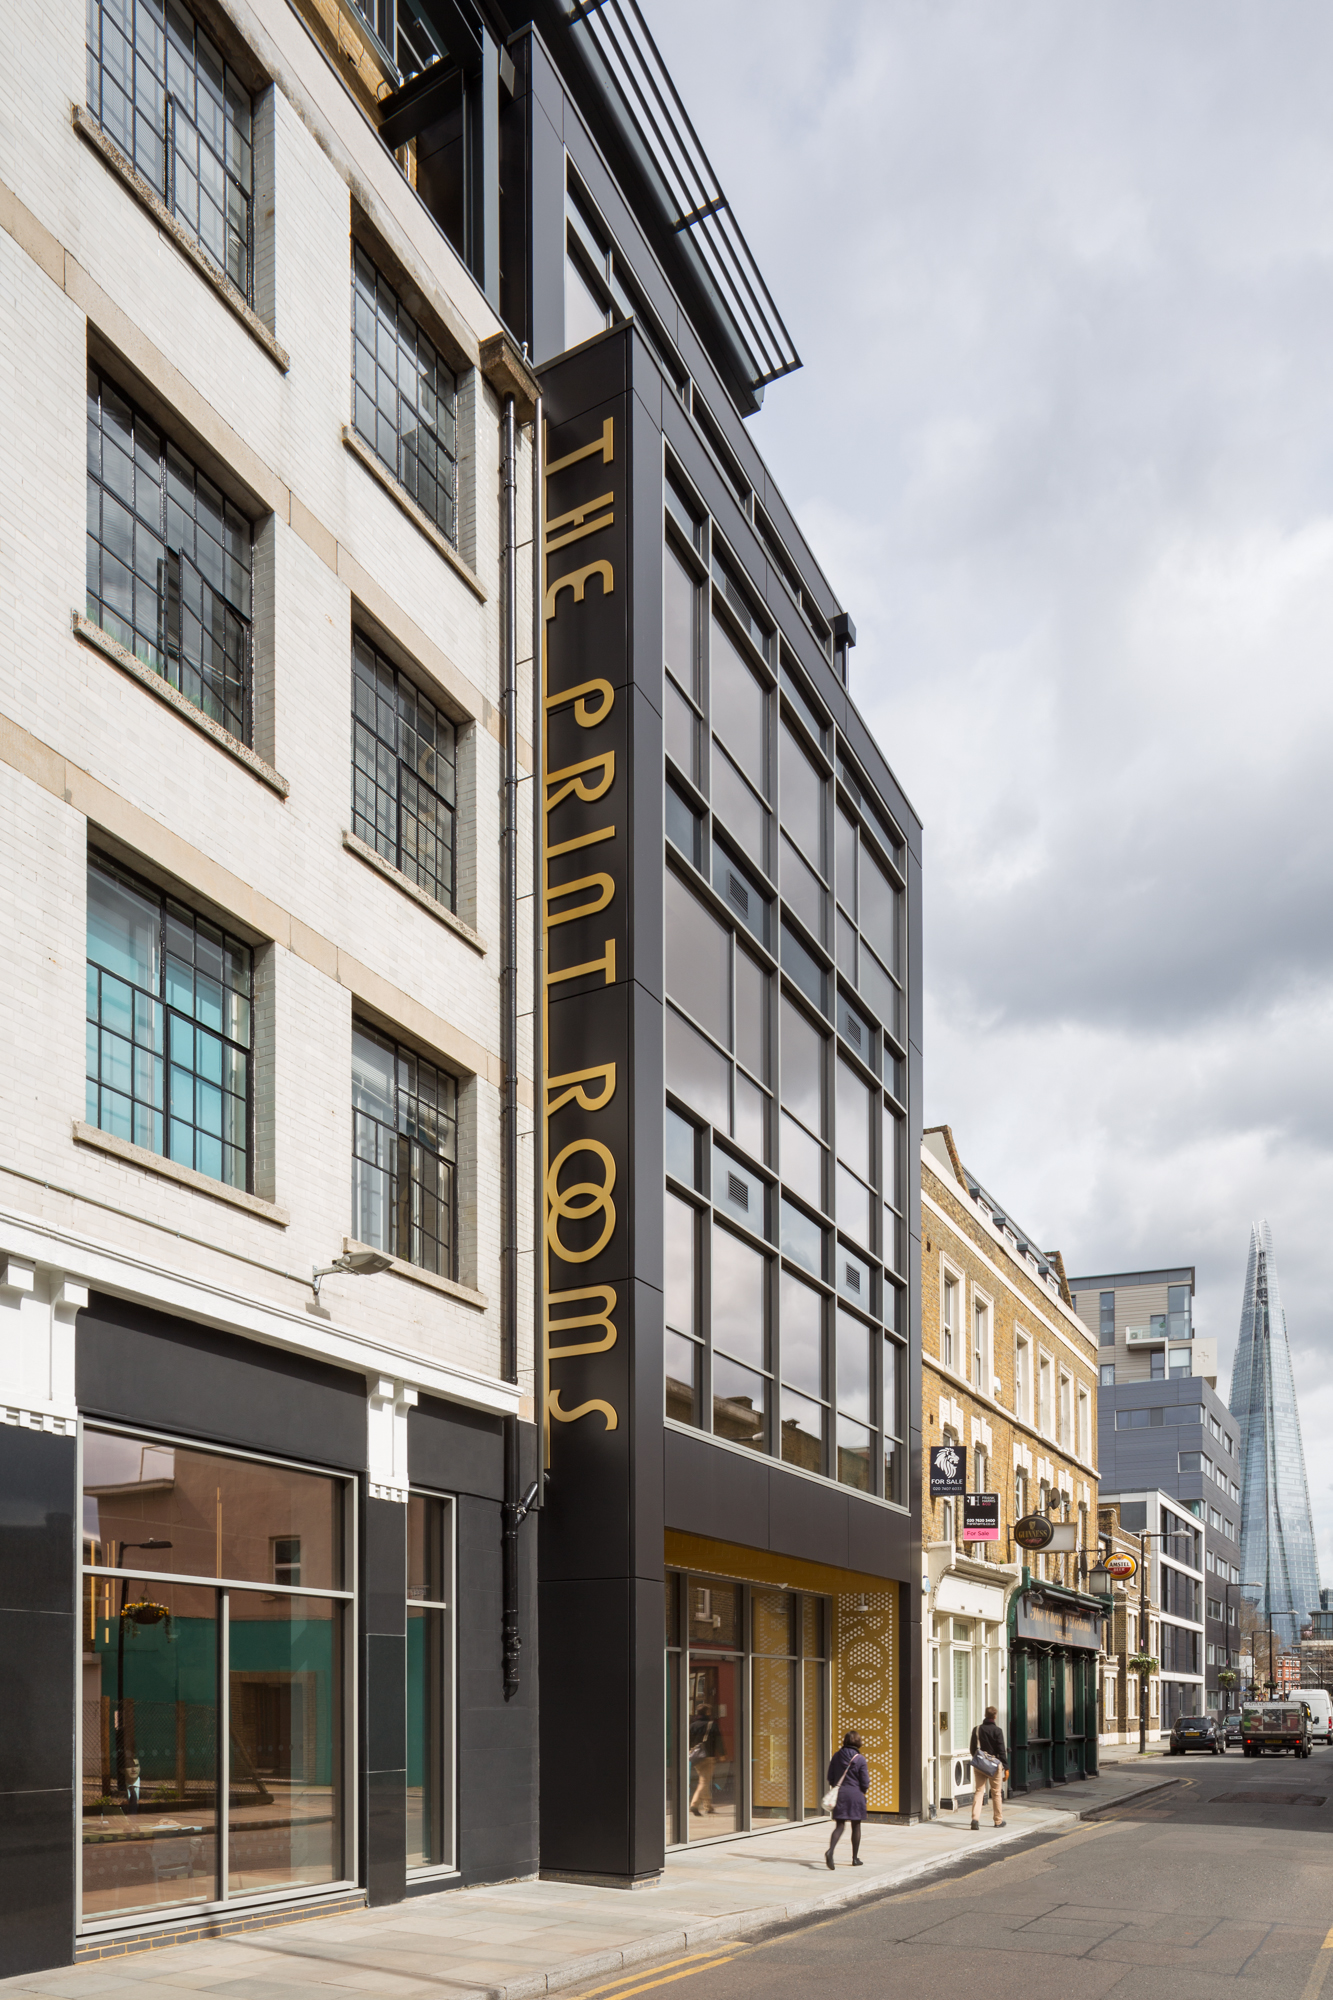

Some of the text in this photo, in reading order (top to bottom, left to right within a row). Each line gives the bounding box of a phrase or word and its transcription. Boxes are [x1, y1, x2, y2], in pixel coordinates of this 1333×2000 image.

[543, 416, 619, 1431] THE PRINT ROOMS
[1018, 1529, 1048, 1539] GUINNESS
[1029, 1606, 1044, 1623] The
